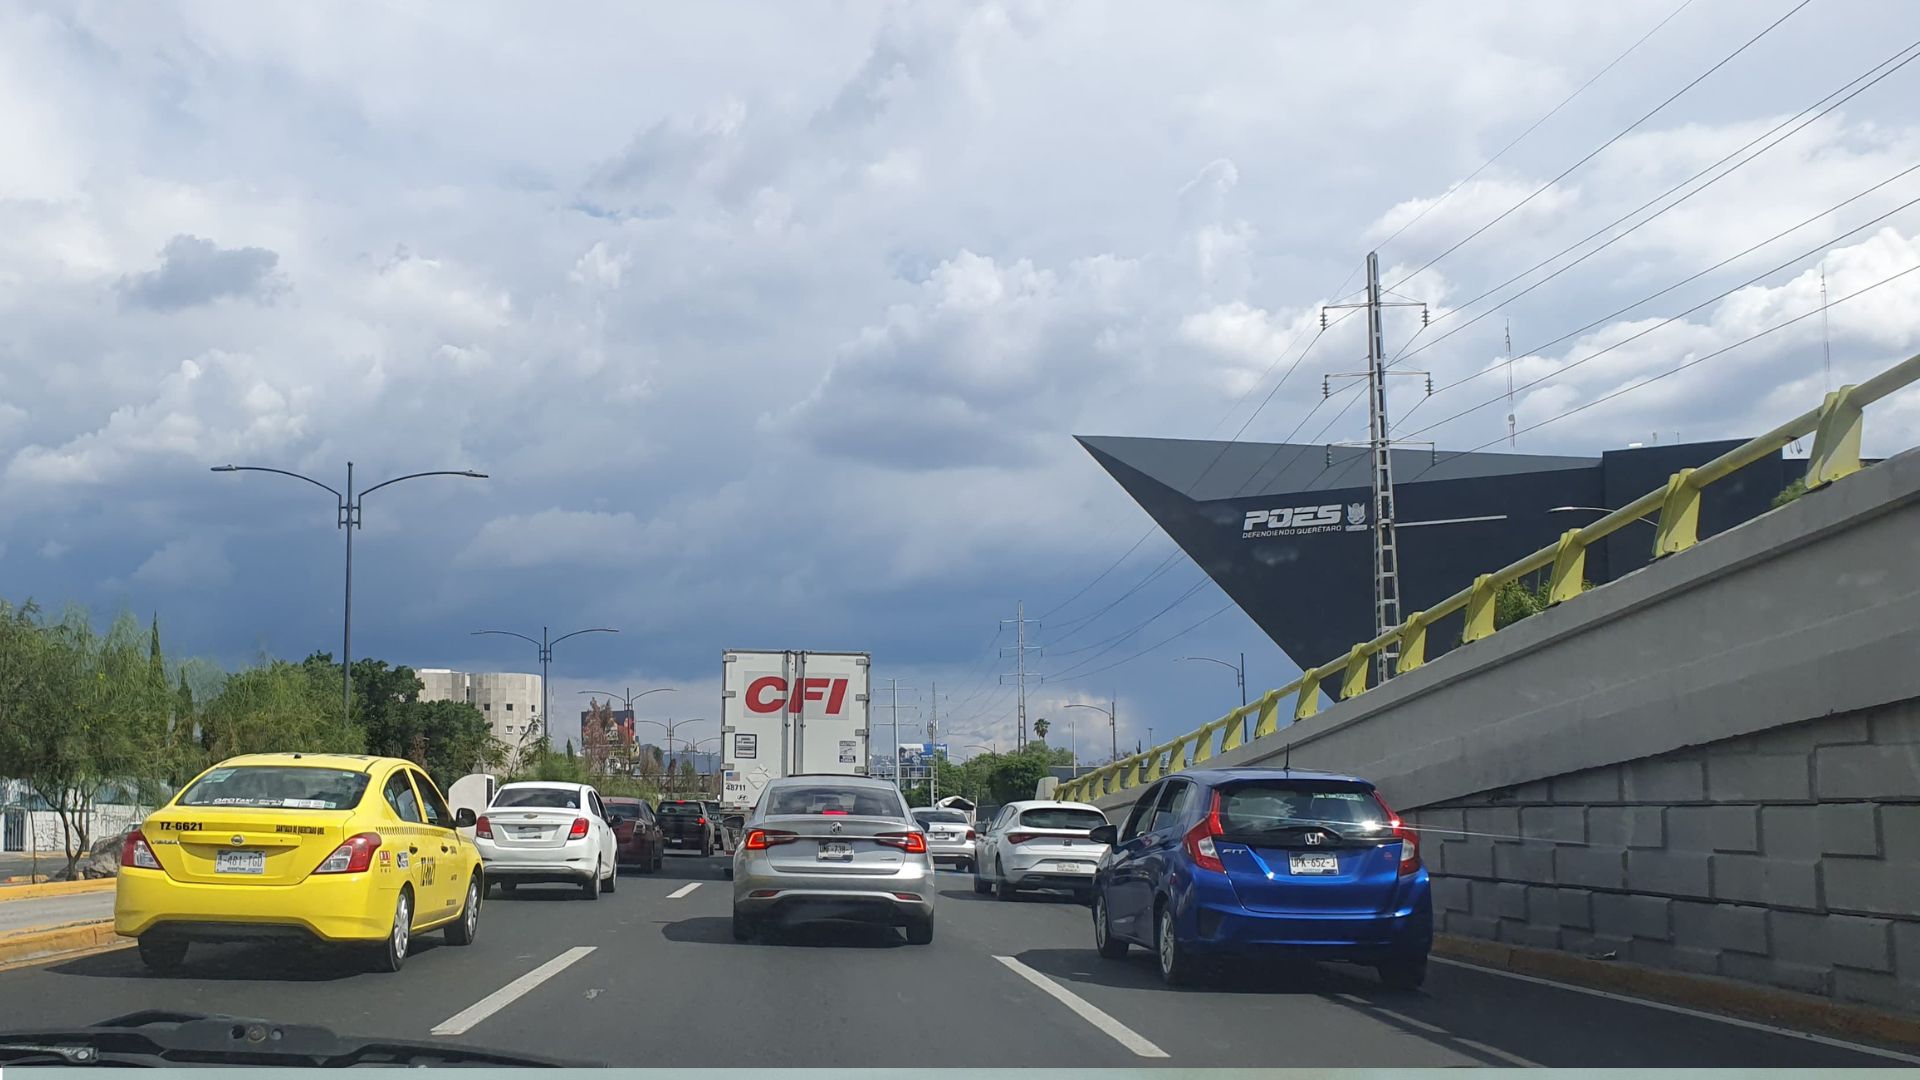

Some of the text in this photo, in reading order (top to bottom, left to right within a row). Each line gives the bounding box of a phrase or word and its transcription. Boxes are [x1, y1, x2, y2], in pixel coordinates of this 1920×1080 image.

[1243, 504, 1342, 530] POES
[1242, 529, 1295, 539] DEFENDIENDO
[745, 676, 849, 714] CFI
[160, 821, 203, 831] TZ-6621
[1291, 855, 1336, 868] UPK-652-J
